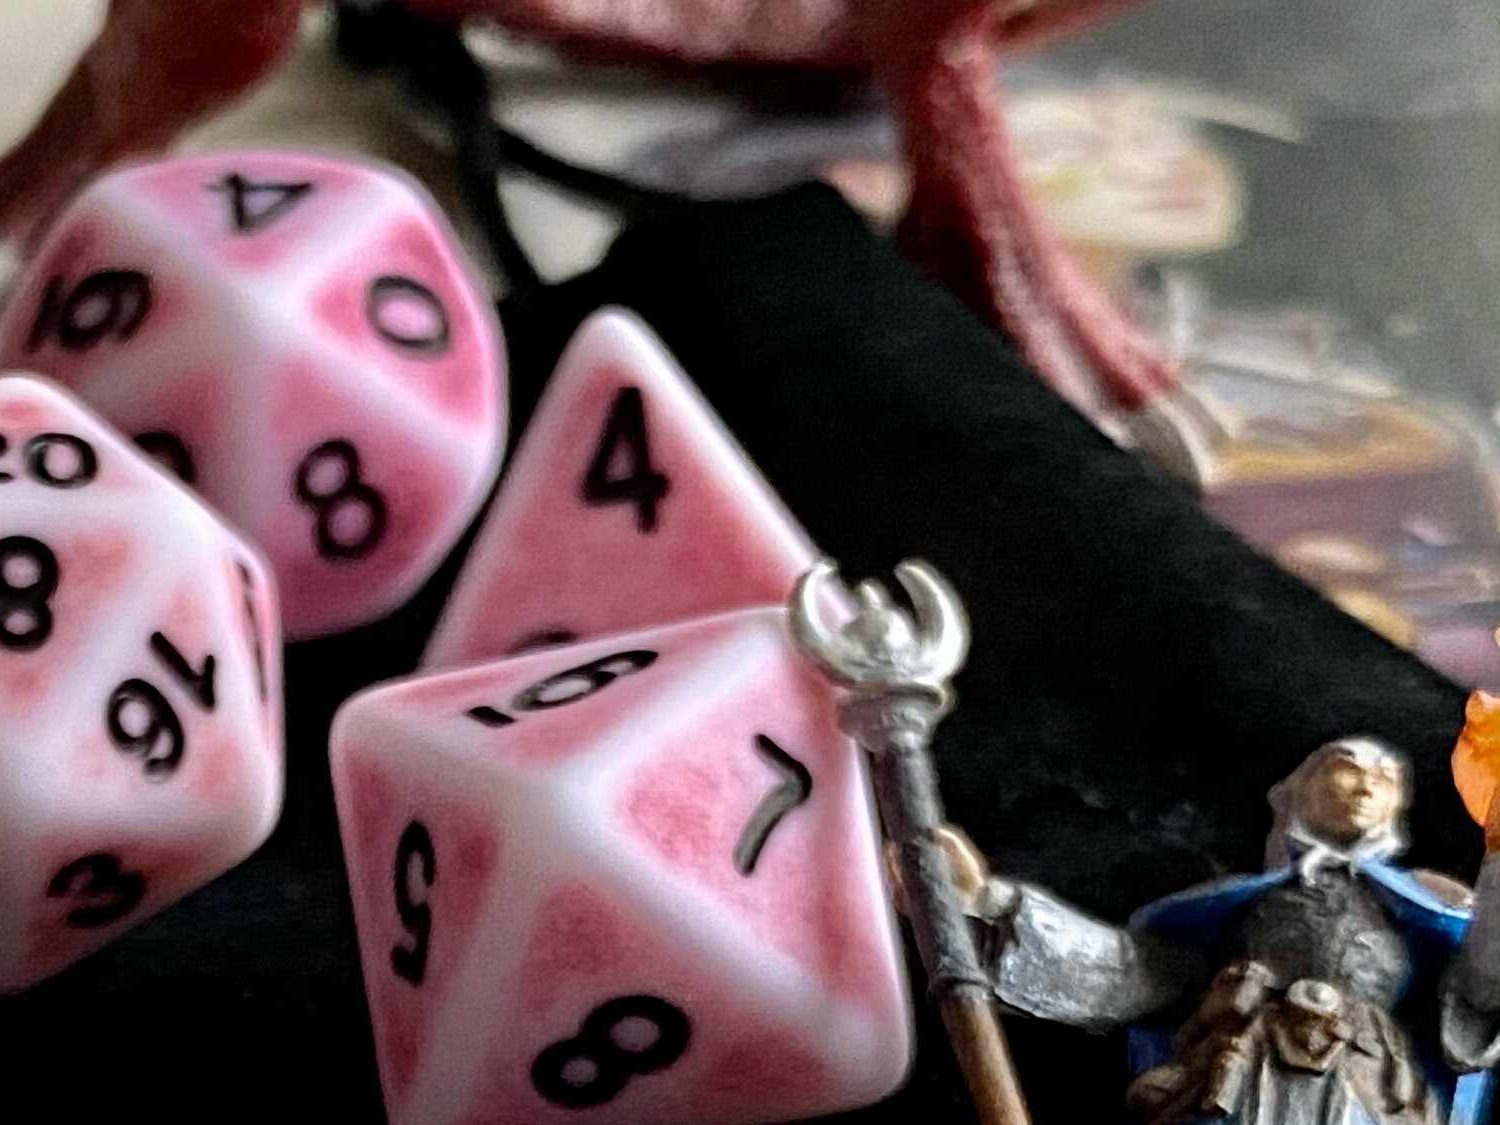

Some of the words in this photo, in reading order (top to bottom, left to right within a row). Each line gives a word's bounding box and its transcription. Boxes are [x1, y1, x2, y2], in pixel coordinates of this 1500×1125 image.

[293, 438, 388, 564] 8
[581, 386, 670, 532] 4
[531, 995, 691, 1109] 8
